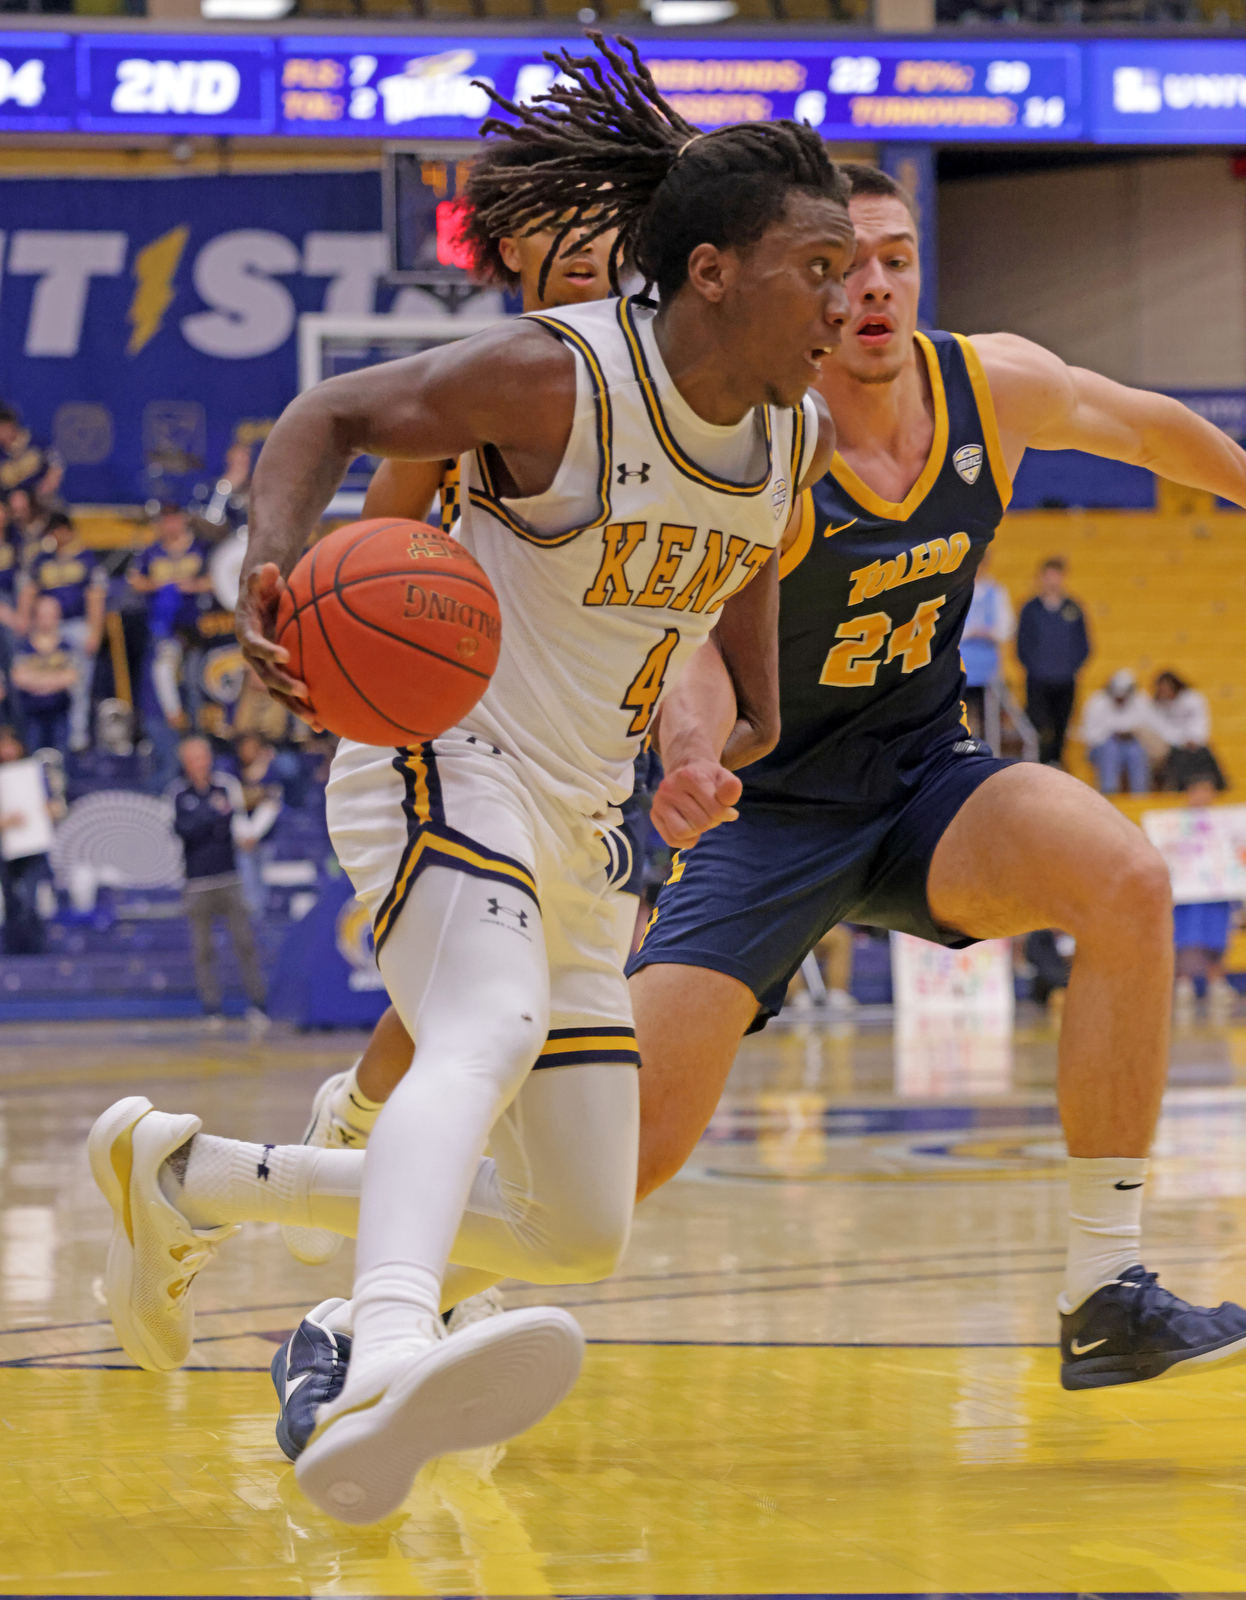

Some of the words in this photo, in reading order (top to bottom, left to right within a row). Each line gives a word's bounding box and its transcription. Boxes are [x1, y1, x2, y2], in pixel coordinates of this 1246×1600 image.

[111, 58, 240, 115] 2ND
[828, 56, 881, 94] 22
[583, 521, 776, 614] KENT
[848, 532, 970, 606] TOLEDO
[819, 594, 946, 687] 24
[619, 628, 680, 738] 4
